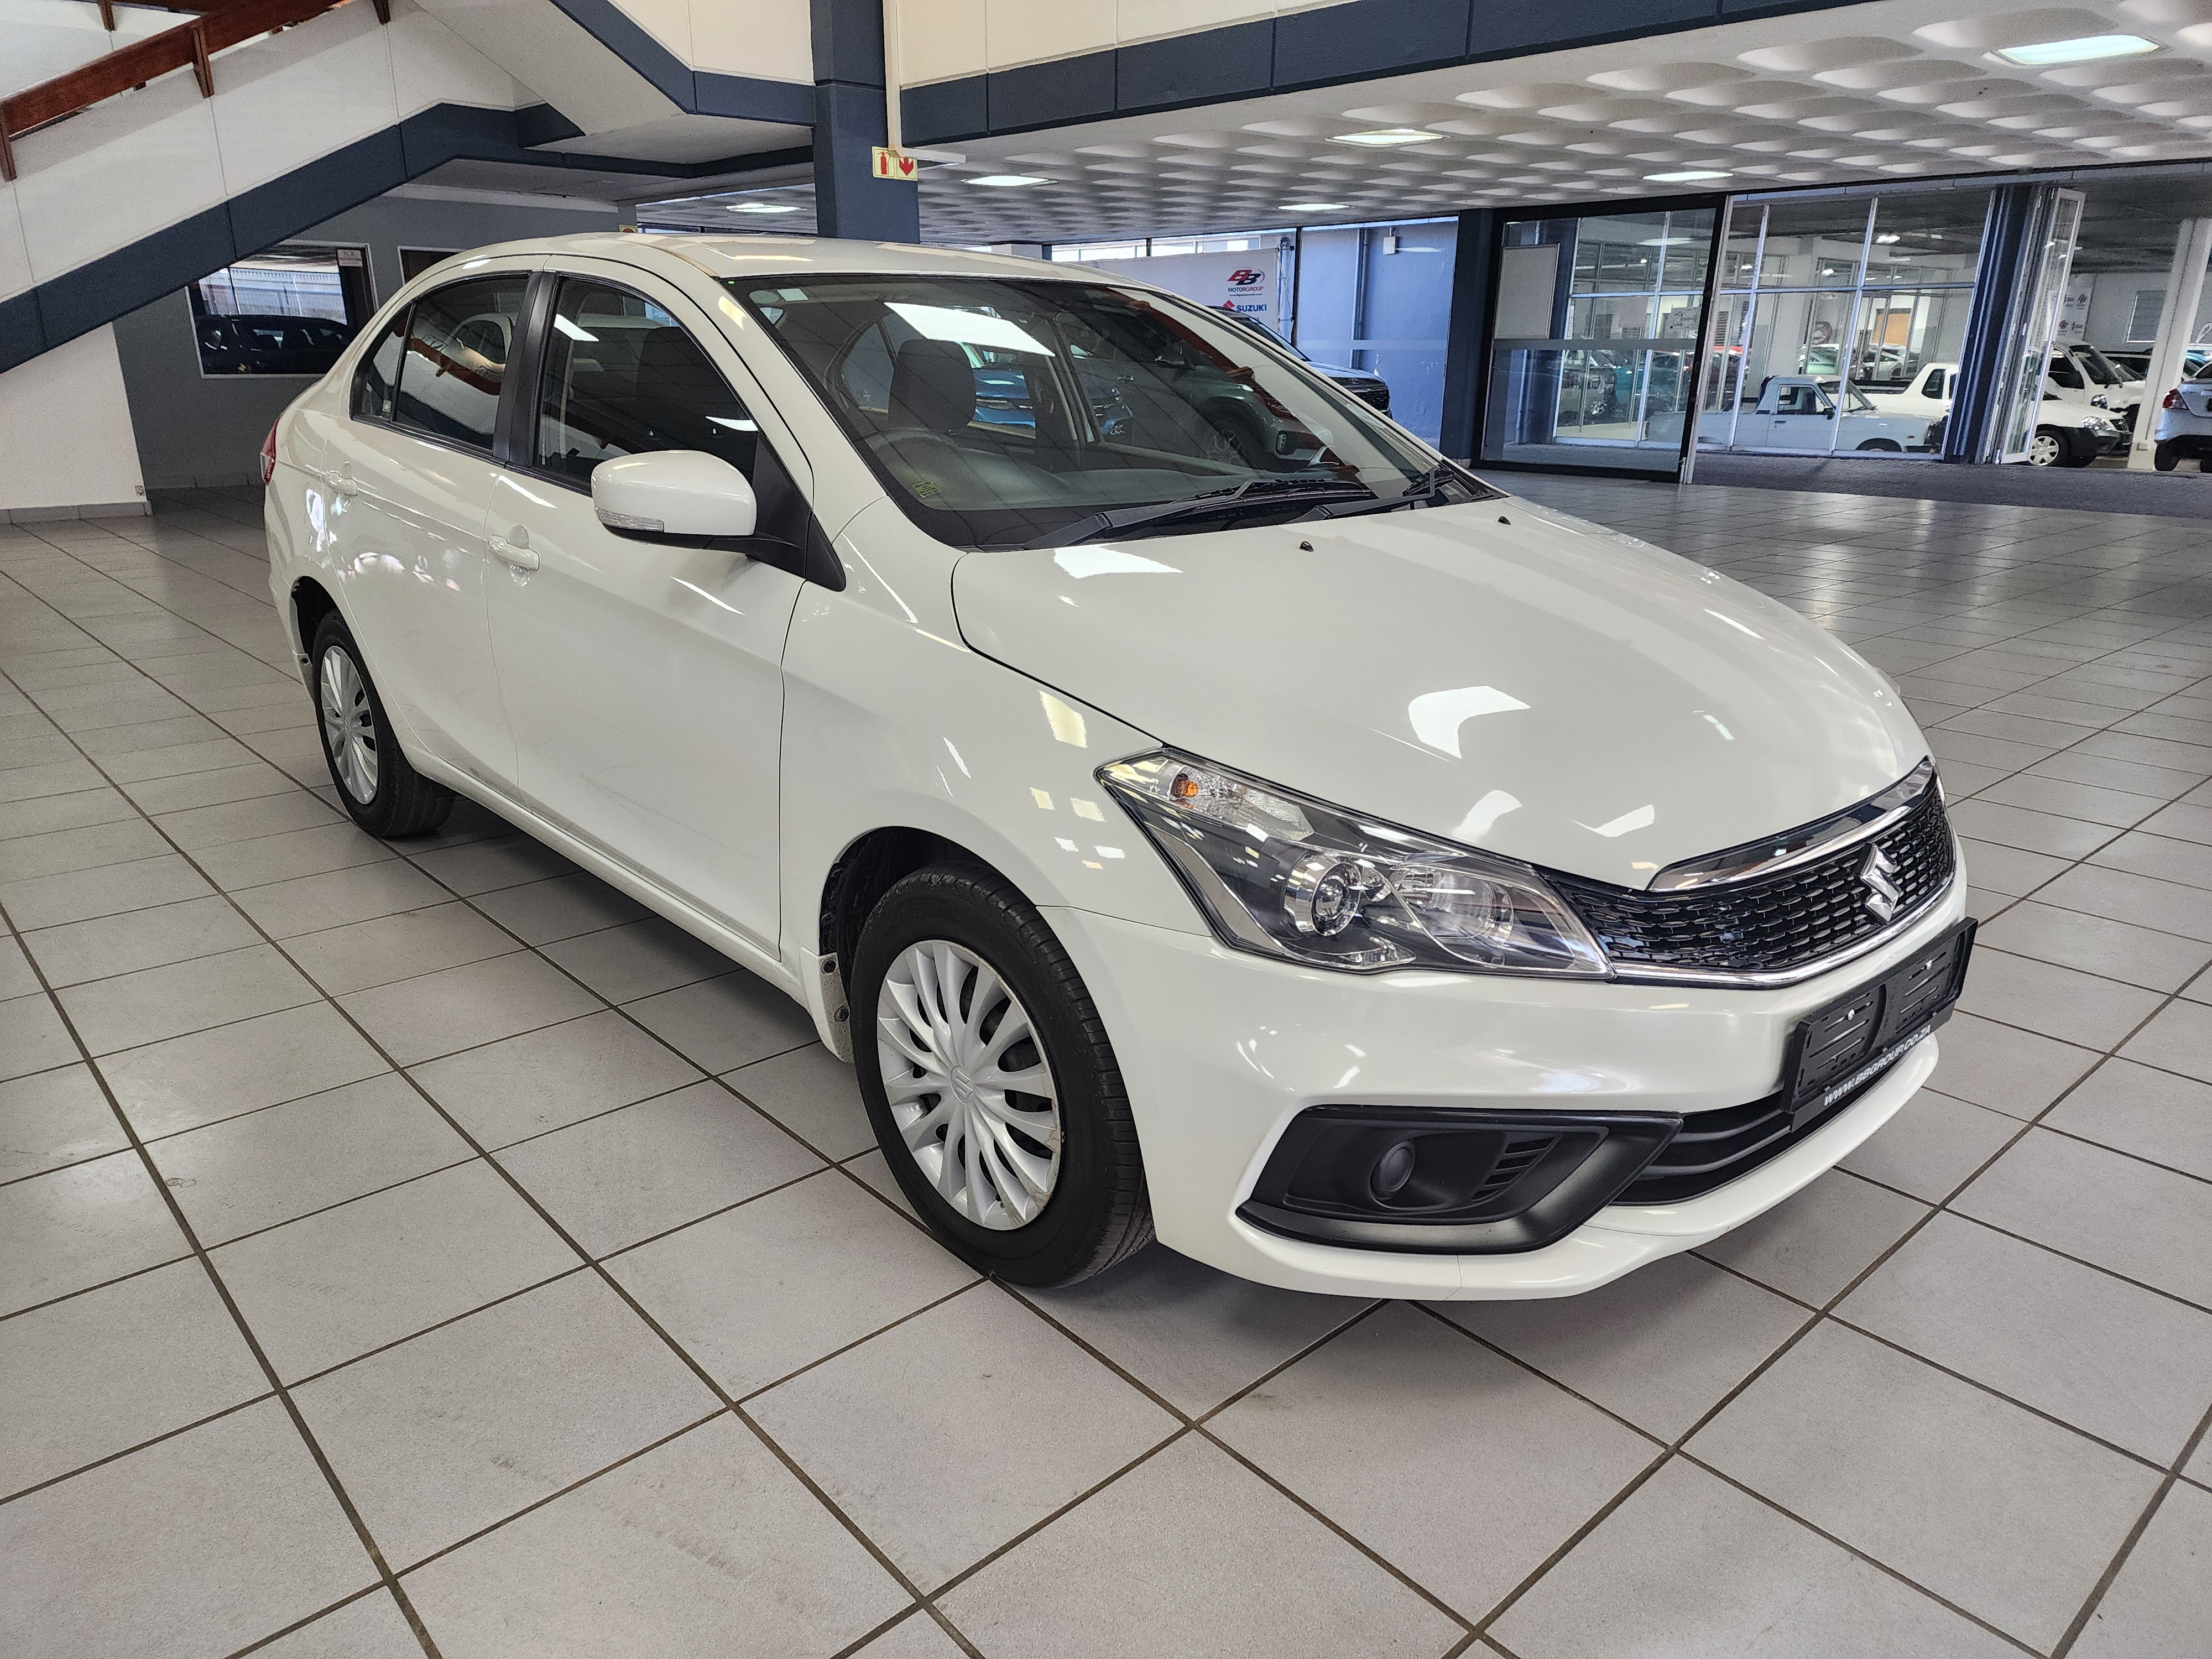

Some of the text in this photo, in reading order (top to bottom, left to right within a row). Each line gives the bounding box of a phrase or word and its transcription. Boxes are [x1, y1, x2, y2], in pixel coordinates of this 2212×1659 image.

[1227, 269, 1261, 285] BB
[1237, 304, 1267, 312] SUZUKI
[1824, 1024, 1931, 1107] WWW.BBGROUP.CO.ZA
